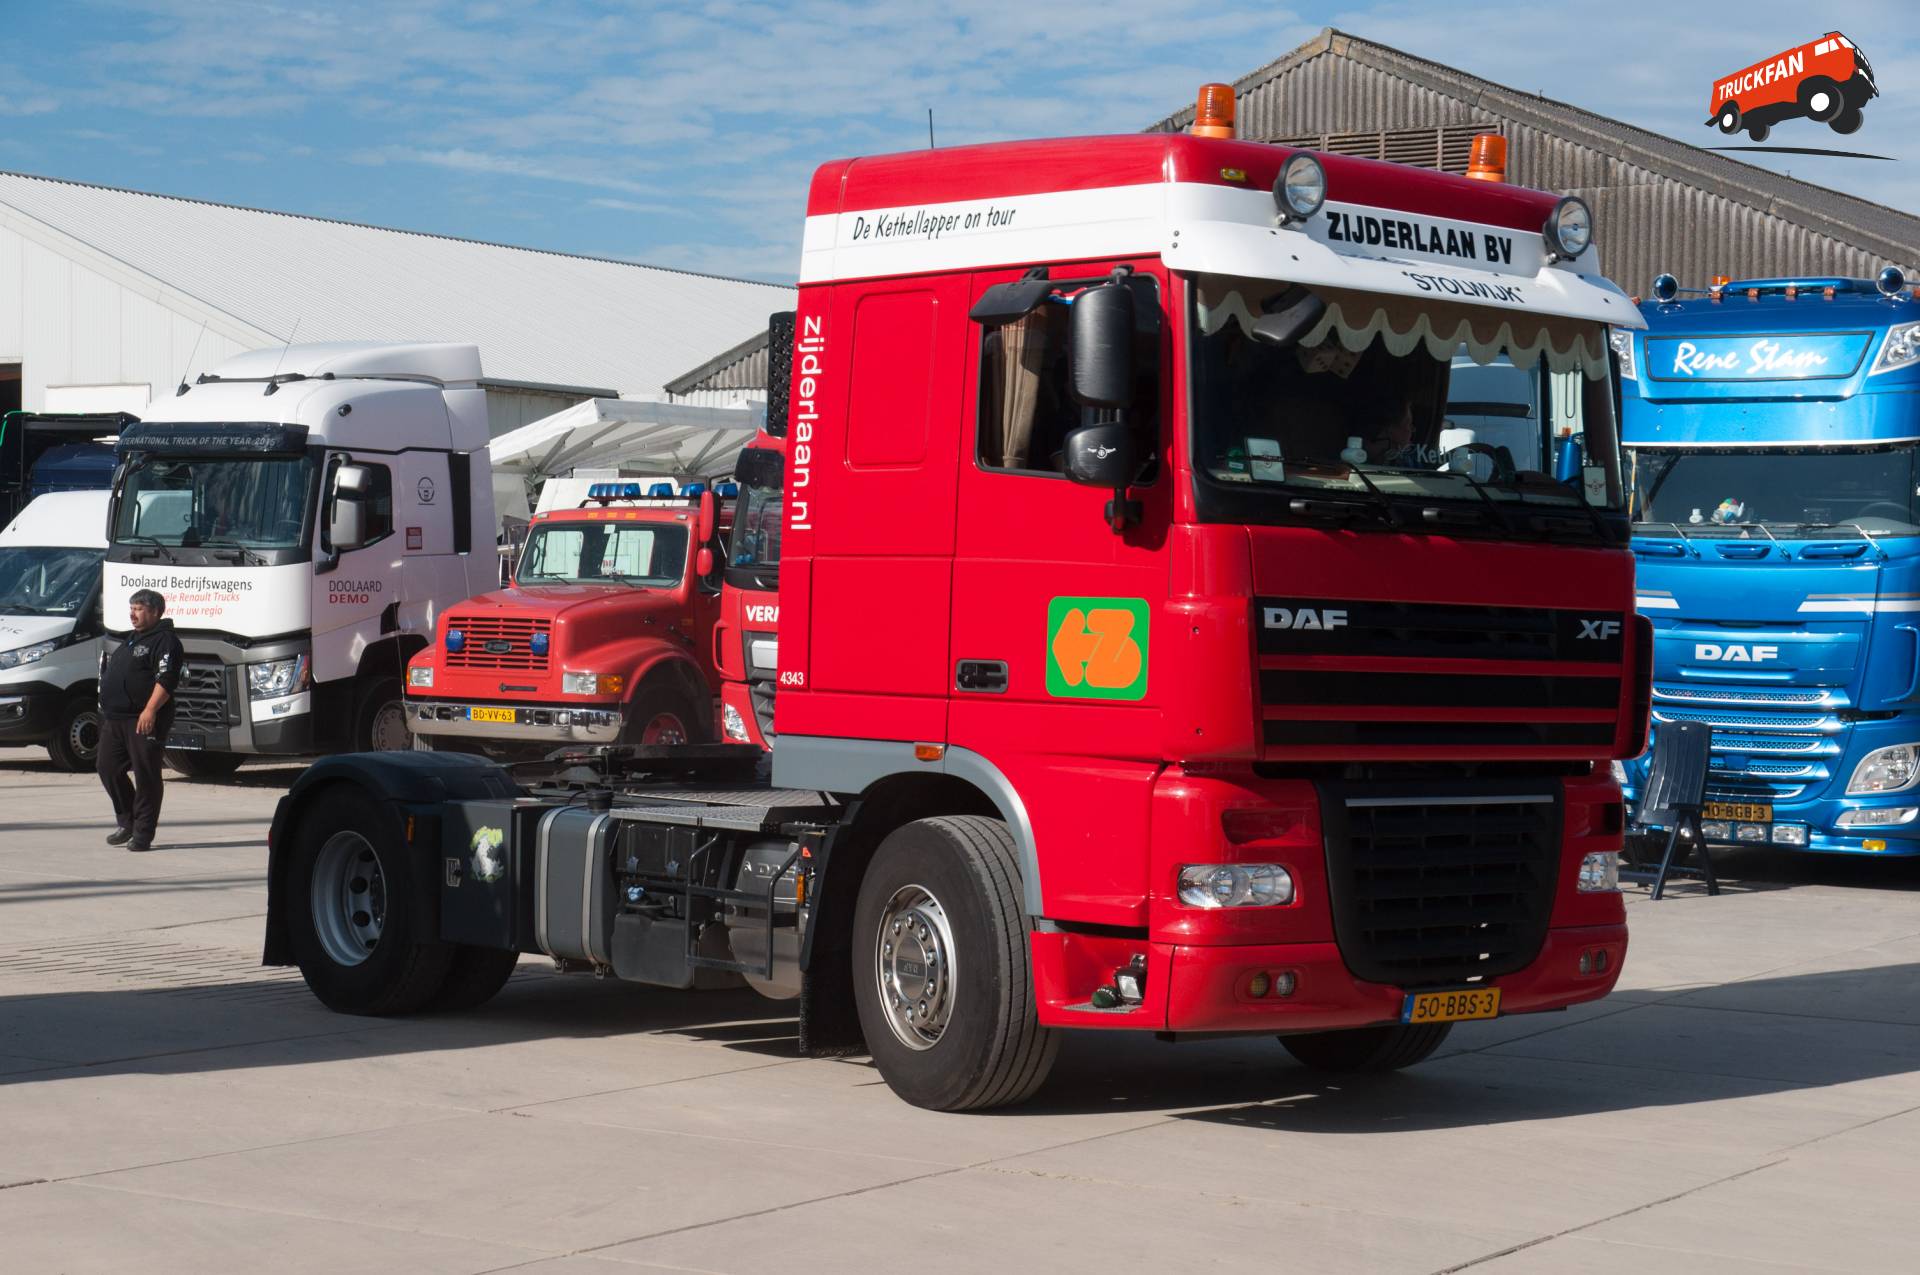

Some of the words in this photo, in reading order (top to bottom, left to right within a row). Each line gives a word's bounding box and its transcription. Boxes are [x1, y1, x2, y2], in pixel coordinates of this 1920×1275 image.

[853, 216, 871, 240] De
[875, 210, 960, 240] Kethellapper
[964, 213, 981, 229] on
[987, 206, 1016, 227] tour
[1326, 211, 1476, 259] ZIJDERLAAN
[1484, 234, 1512, 264] BV
[1673, 342, 1740, 375] Rene
[1746, 339, 1828, 374] Stam
[791, 316, 824, 530] zijderlaan.nl
[172, 436, 197, 446] TRUCK
[199, 436, 210, 445] OF
[211, 436, 228, 445] THE
[229, 436, 251, 446] YEAR
[121, 575, 168, 588] Doolaard
[171, 576, 253, 592] Bedrijfswagens
[329, 580, 382, 592] DOOLAARD
[179, 592, 211, 602] Renault
[214, 592, 240, 602] Trucks
[329, 593, 369, 604] DEMO
[176, 606, 185, 615] in
[186, 607, 200, 616] uw
[201, 605, 223, 617] regio
[1263, 607, 1348, 630] DAF
[1576, 619, 1620, 640] XF
[1695, 644, 1778, 662] DAF
[780, 671, 804, 685] 4343
[473, 709, 512, 720] BD-VV-63
[1417, 993, 1494, 1018] 50-BBS-3
